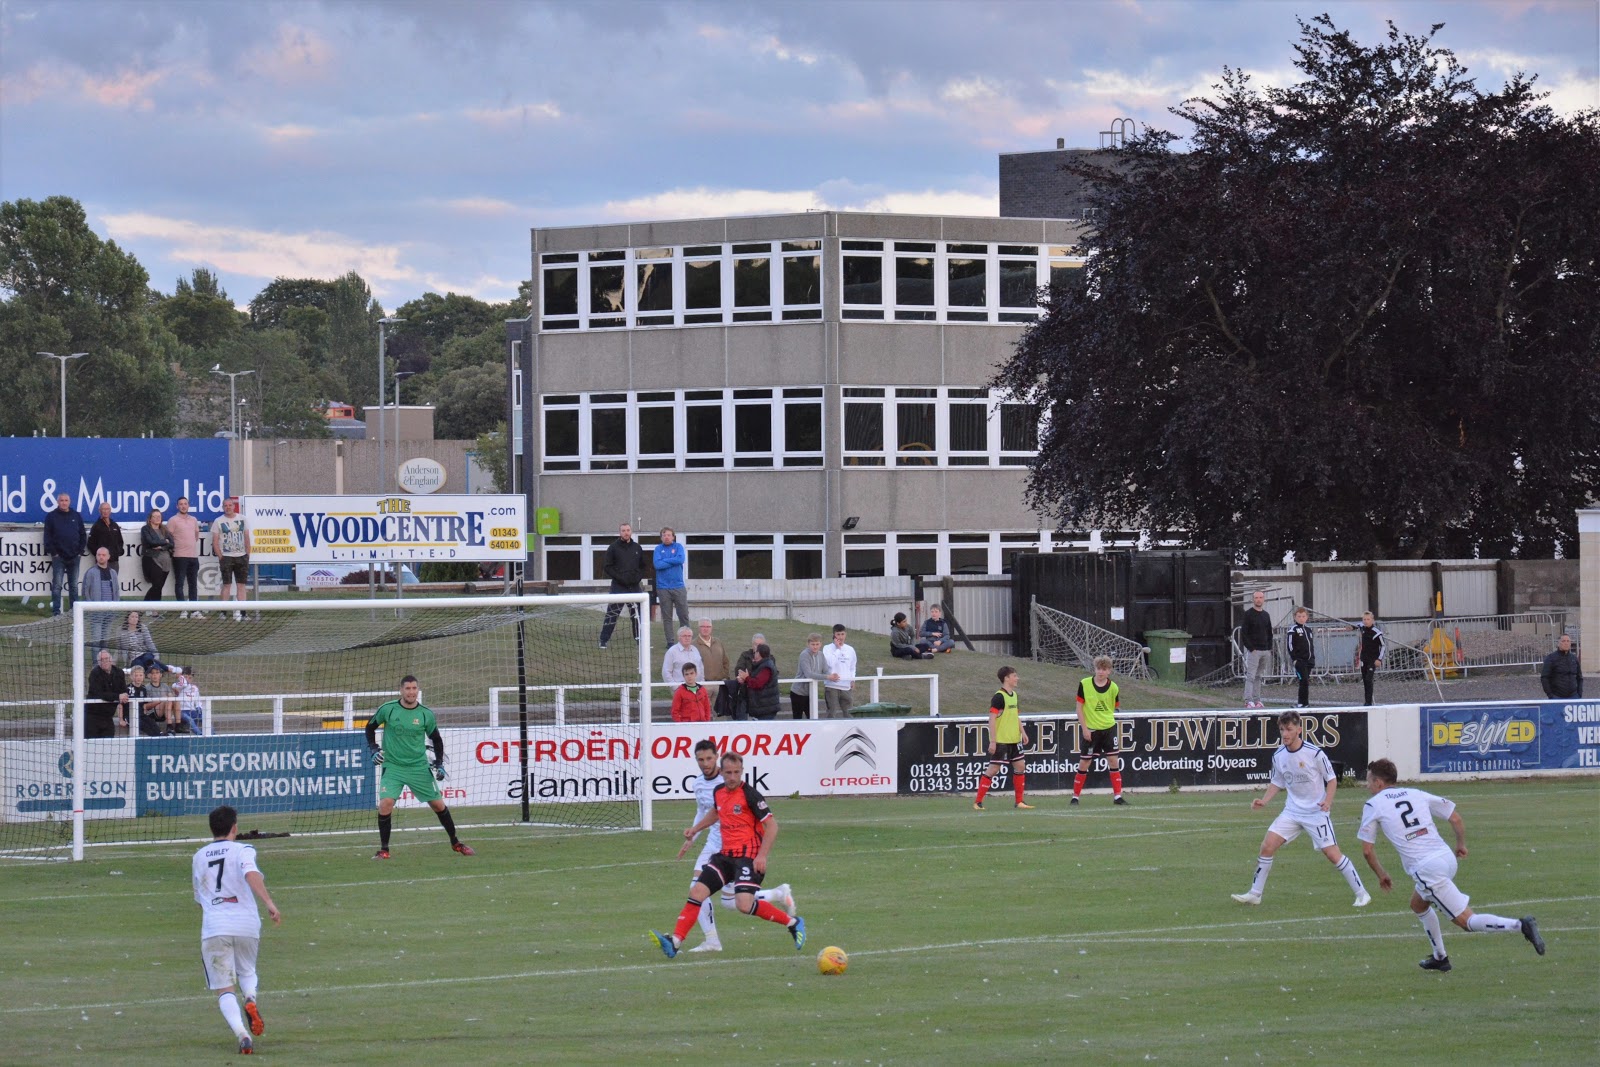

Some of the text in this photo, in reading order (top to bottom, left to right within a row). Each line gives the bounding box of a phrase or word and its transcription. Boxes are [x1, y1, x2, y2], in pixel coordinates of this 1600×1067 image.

[403, 464, 439, 475] Anderson
[0, 475, 225, 515] ld & Munro Ltd
[376, 498, 411, 514] THE
[289, 511, 486, 548] WOODCENTRE
[492, 528, 517, 538] 01343
[257, 537, 288, 545] JOINERY
[489, 539, 520, 549] 540140
[251, 546, 294, 554] MERCHANTS
[1065, 719, 1137, 754] TE
[1145, 714, 1341, 751] JEWELLRS
[708, 733, 811, 757] MORAY
[149, 748, 362, 774] TRANSFORMING THE
[910, 755, 1257, 778] 01343 54256 stablishe 190 Celebrating 50years
[1448, 761, 1472, 772] SIGNS
[1482, 759, 1522, 771] GRAPHICS
[16, 780, 126, 798] ROBERSON
[146, 774, 365, 801] BUILT ENVIRONMENT
[910, 776, 1008, 792] 01343 55187
[1394, 800, 1420, 828] 2
[1316, 824, 1328, 839] 17
[205, 847, 229, 858] CAWLEY
[208, 857, 226, 893] 7
